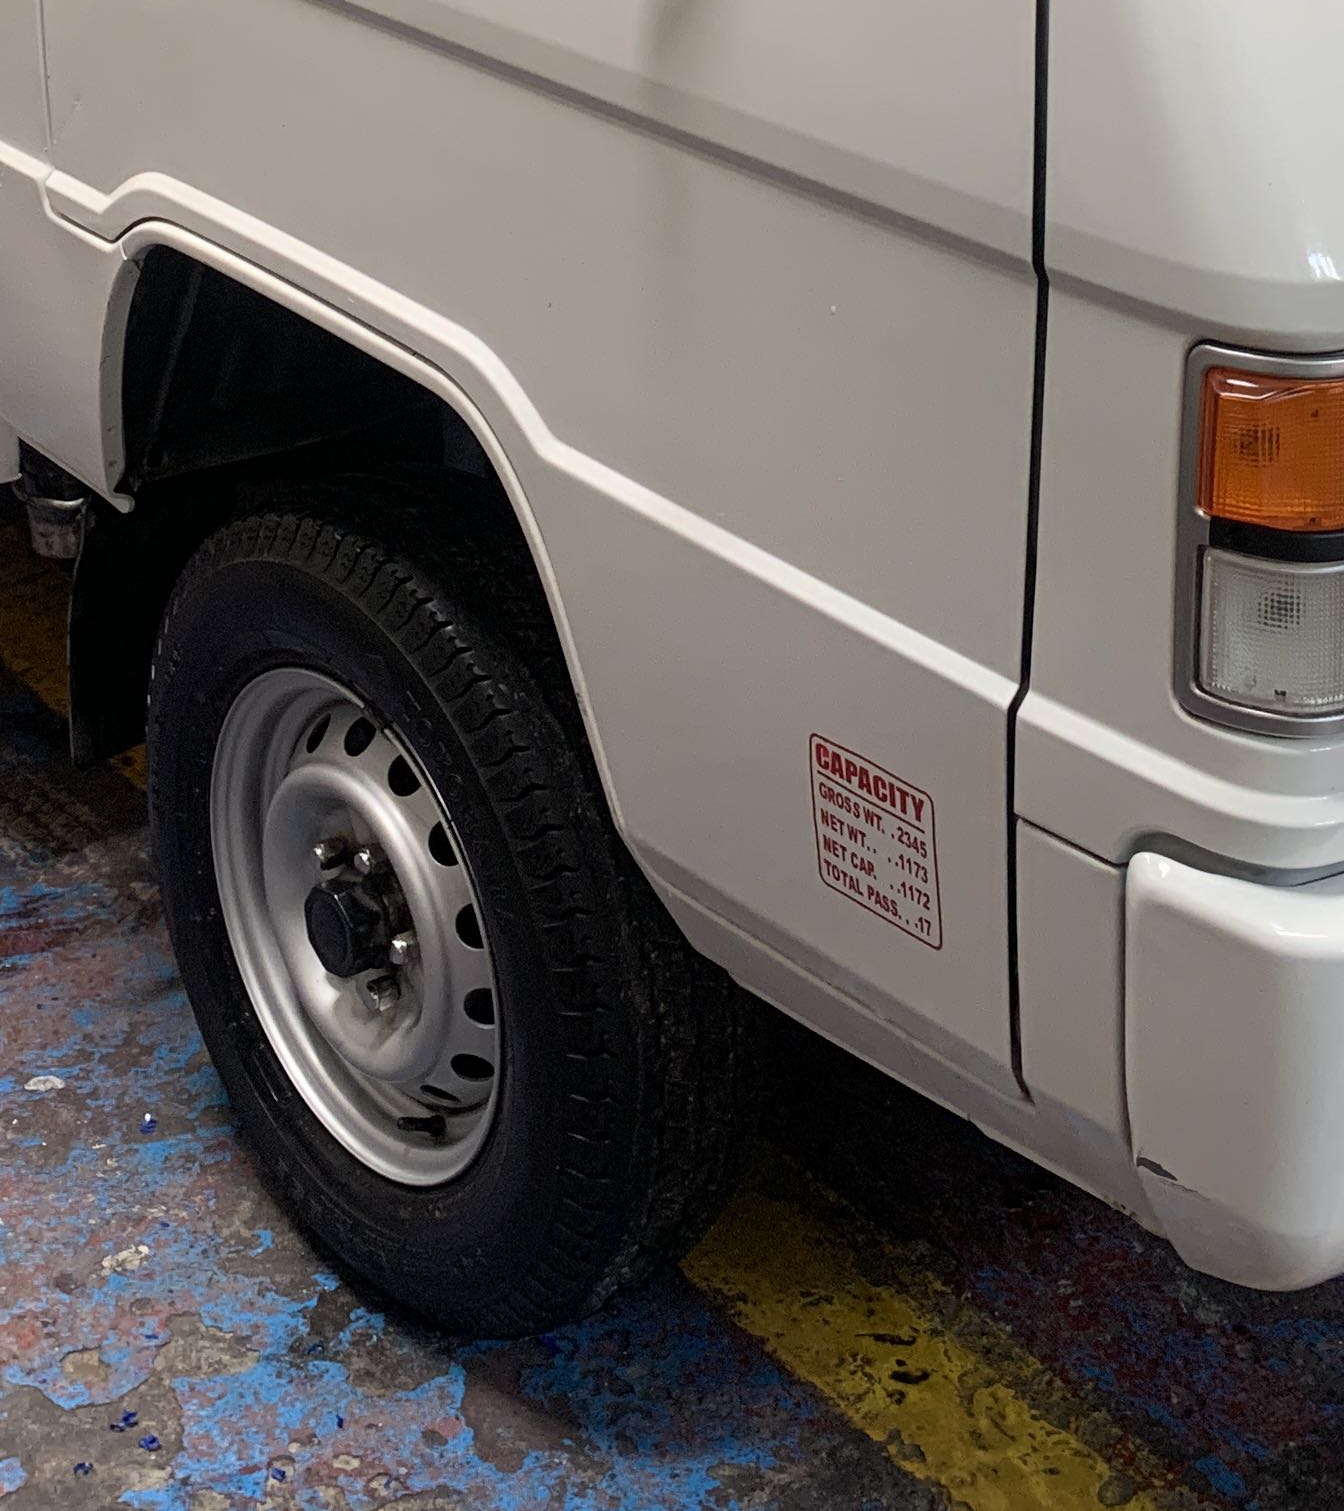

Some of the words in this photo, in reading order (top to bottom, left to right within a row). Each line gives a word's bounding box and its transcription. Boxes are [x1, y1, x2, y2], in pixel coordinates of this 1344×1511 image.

[815, 743, 924, 822] CAPACITY
[818, 782, 860, 818] GROSS
[820, 807, 845, 837] NET
[823, 834, 847, 862] NET
[823, 858, 864, 896] TOTAL
